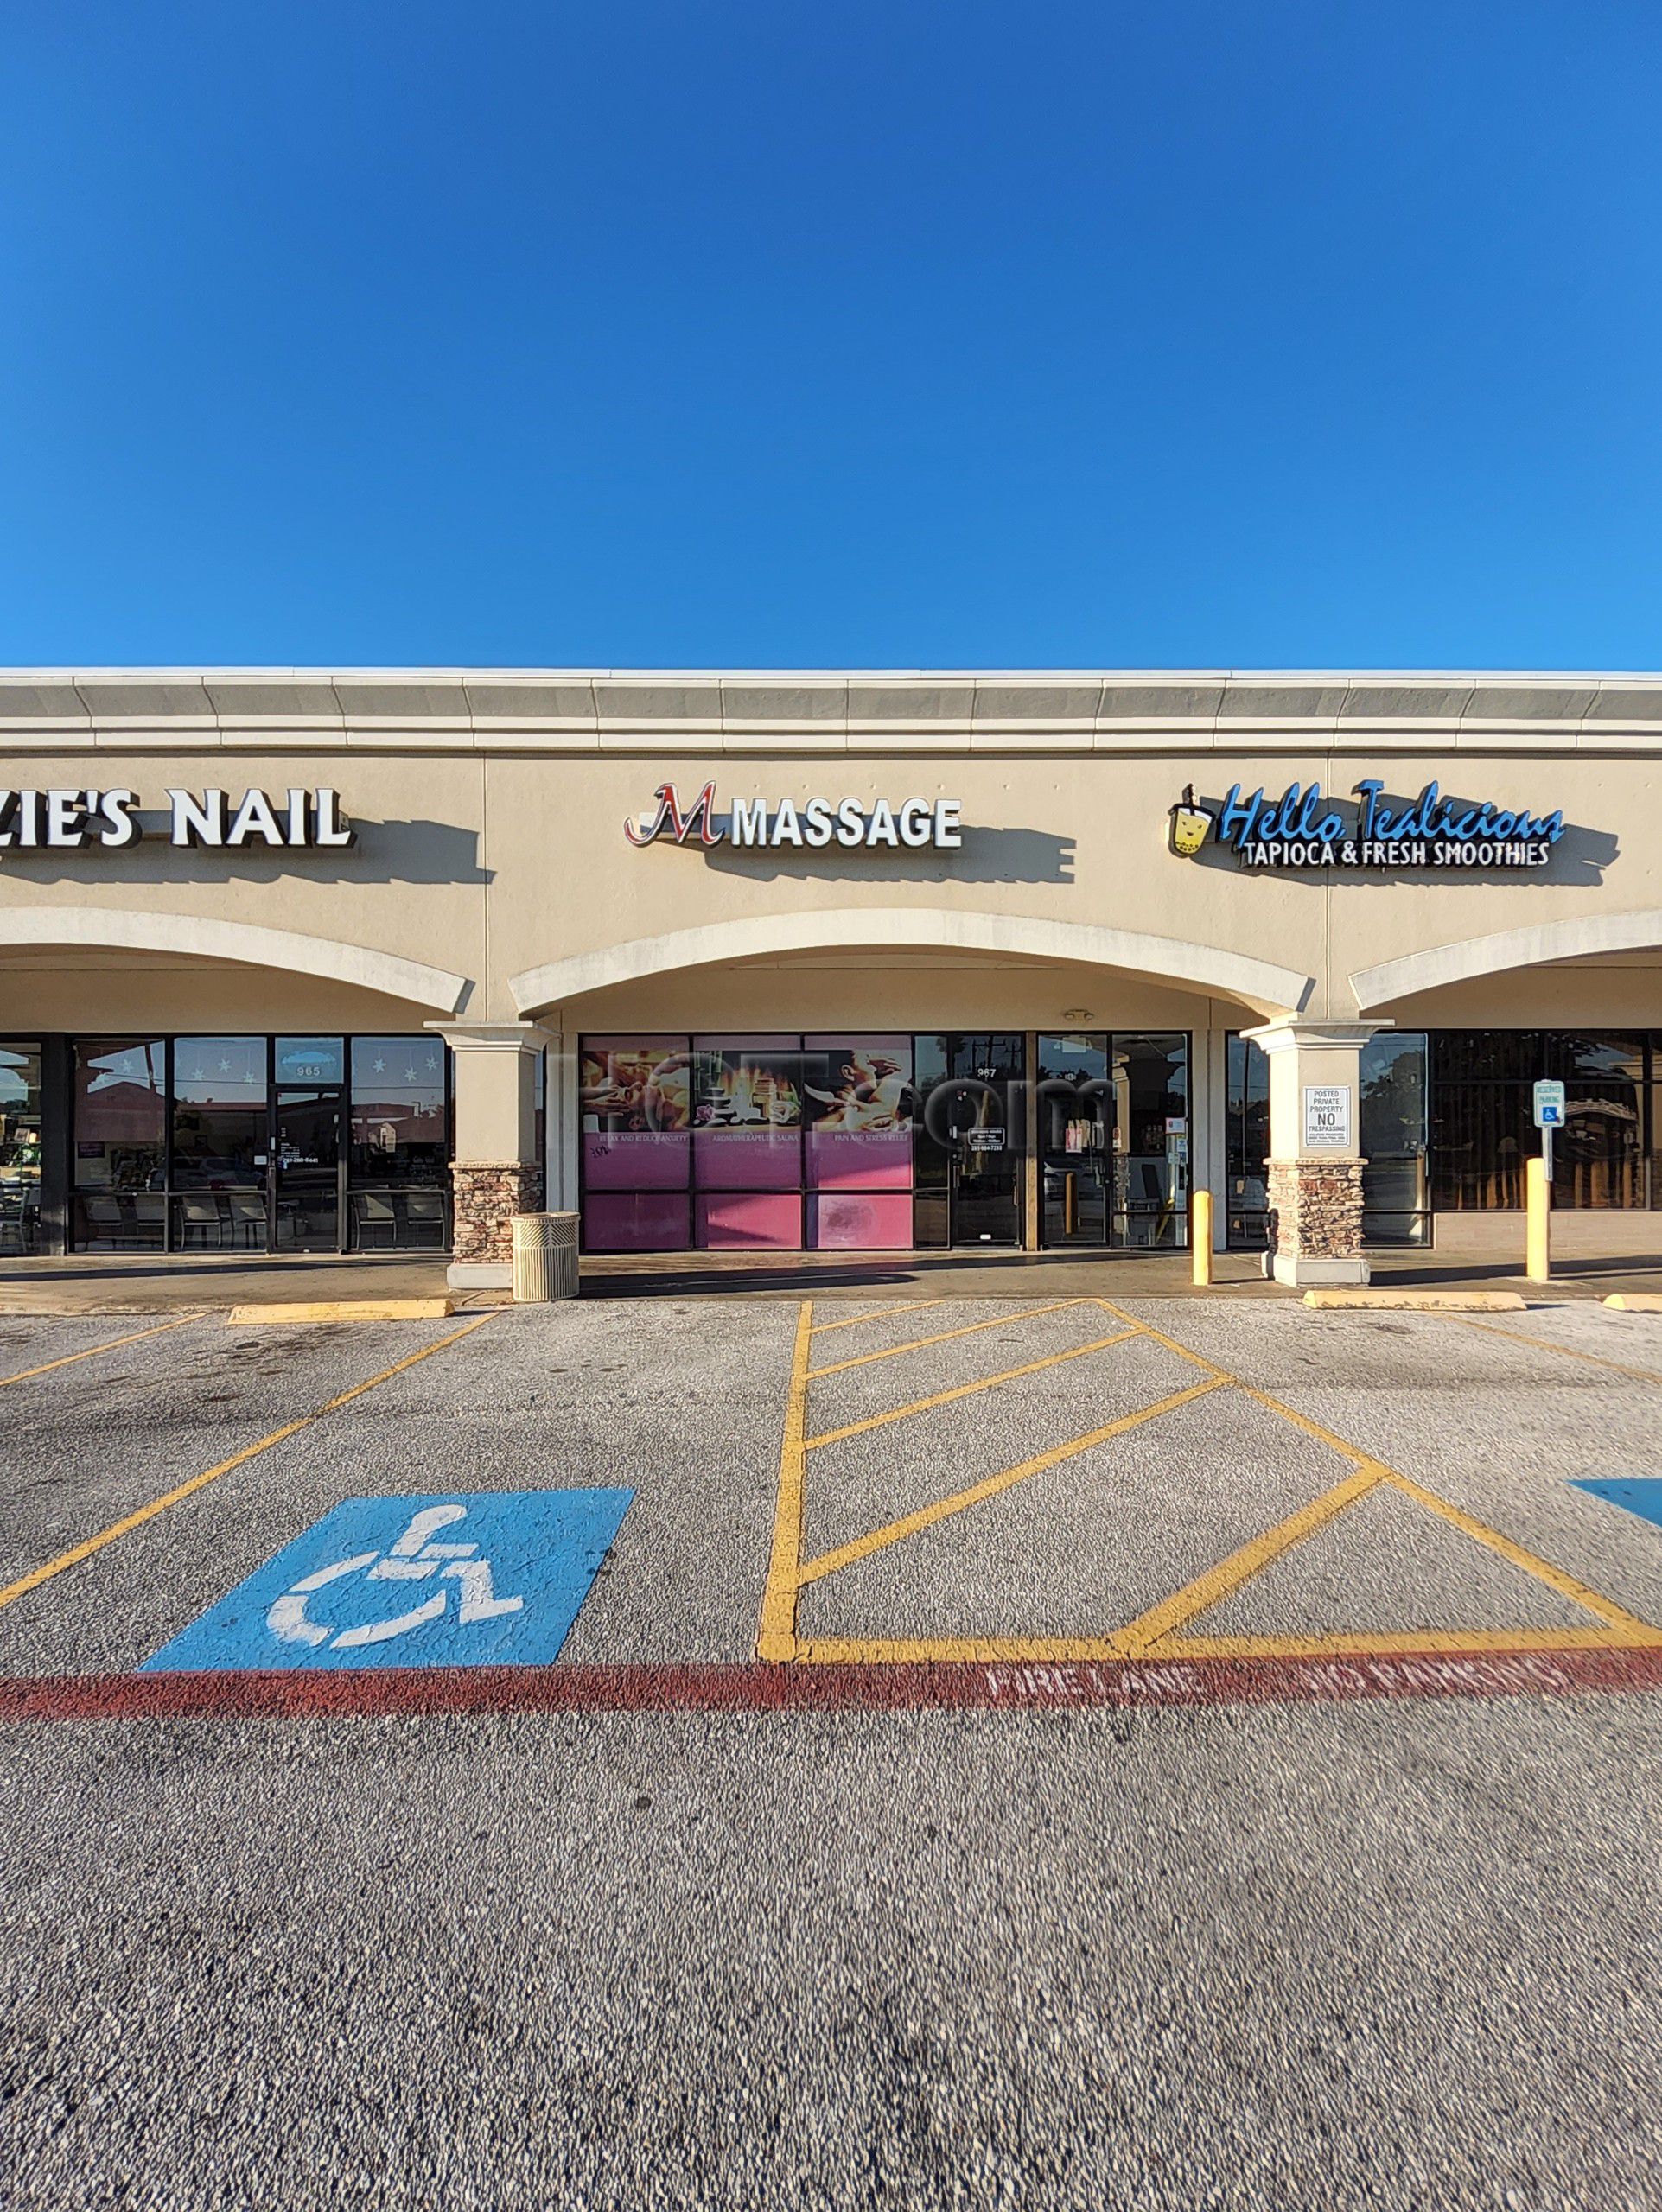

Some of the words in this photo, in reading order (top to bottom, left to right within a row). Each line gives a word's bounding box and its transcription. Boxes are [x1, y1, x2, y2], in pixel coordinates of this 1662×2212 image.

[165, 788, 351, 846] NAIL
[623, 779, 726, 846] M
[731, 797, 962, 848] MASSAGE
[1352, 779, 1566, 843] Tealicious
[1243, 842, 1335, 865] TAPIOCA
[1340, 841, 1359, 864] &
[1362, 842, 1426, 865] FRESH
[1434, 842, 1550, 866] SMOOTHIES
[296, 1066, 321, 1077] 965
[977, 1068, 997, 1078] 967
[1317, 1112, 1336, 1126] NO
[985, 1666, 1084, 1696] FIRE
[1092, 1664, 1208, 1696] LANE
